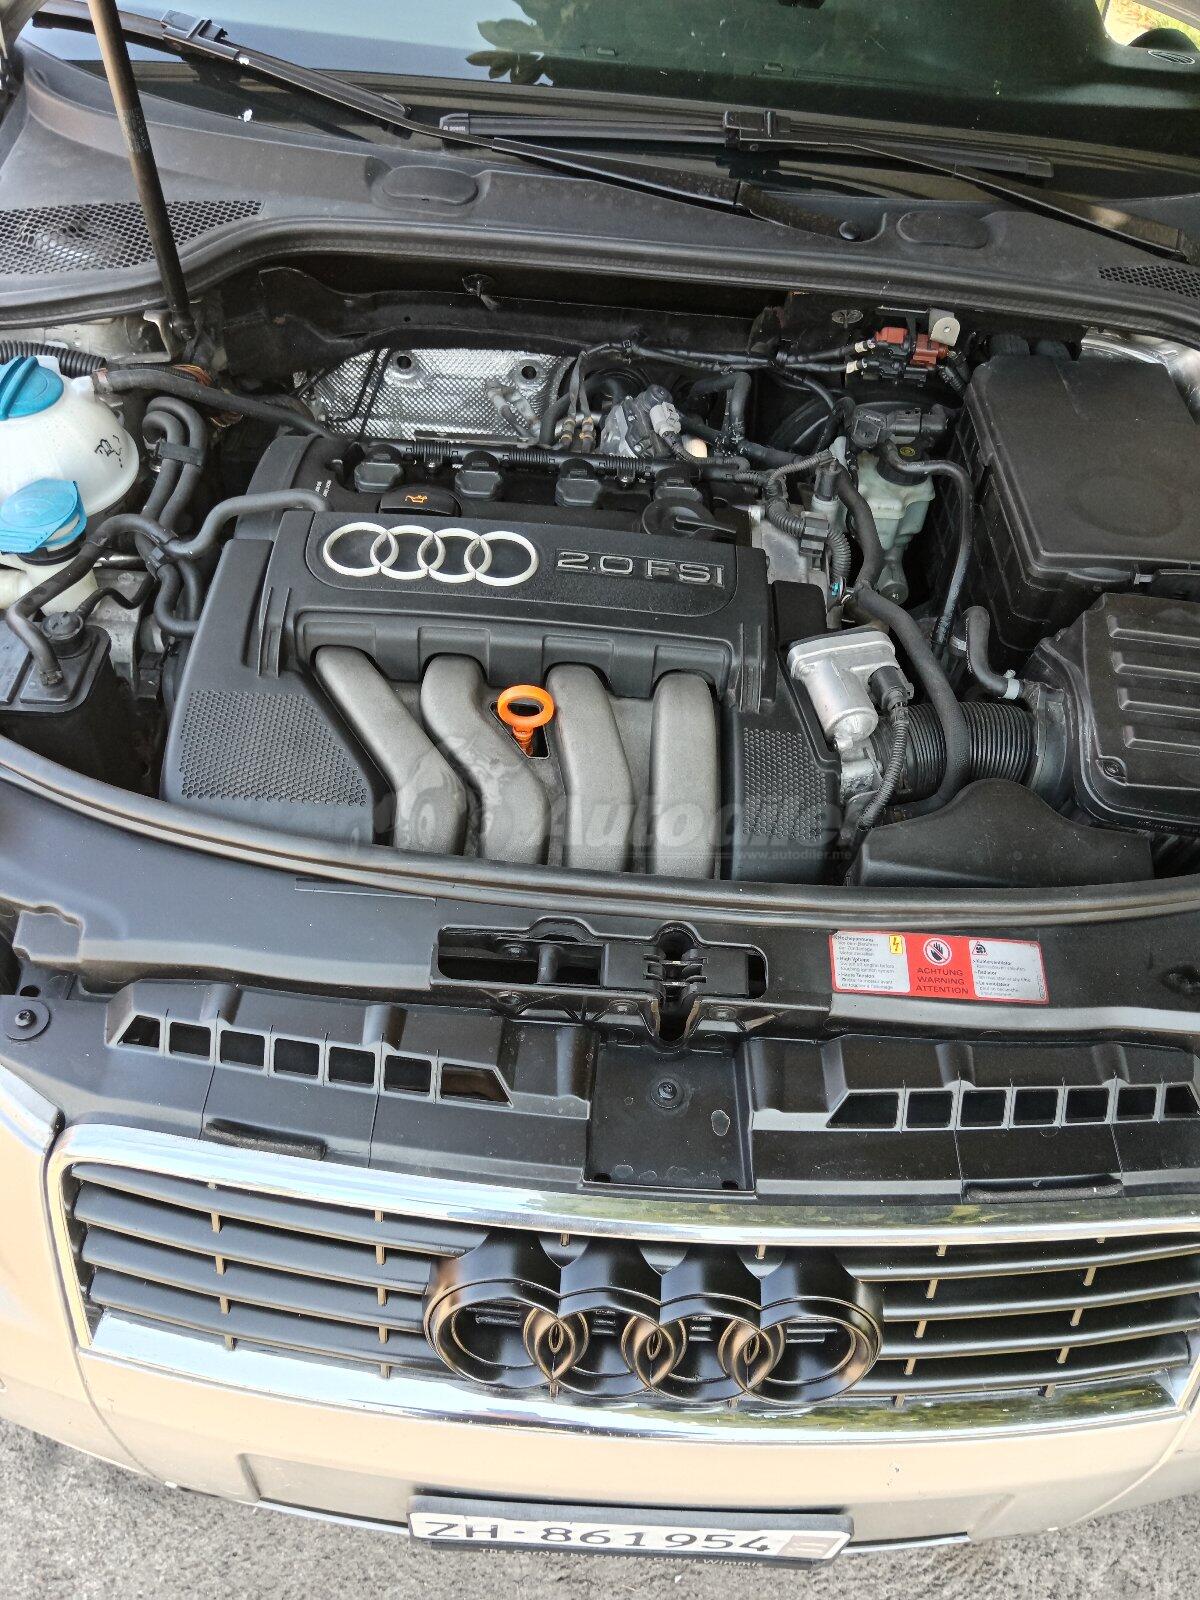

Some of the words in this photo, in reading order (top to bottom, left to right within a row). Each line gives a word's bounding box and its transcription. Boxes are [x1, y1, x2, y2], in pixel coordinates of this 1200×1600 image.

[557, 551, 634, 576] 2.0
[645, 559, 725, 588] FSI
[917, 967, 964, 976] ACHTUNG
[917, 976, 965, 985] WARNING
[915, 985, 969, 994] ATTENTION
[425, 1521, 498, 1539] ZH
[540, 1526, 771, 1552] 861954
